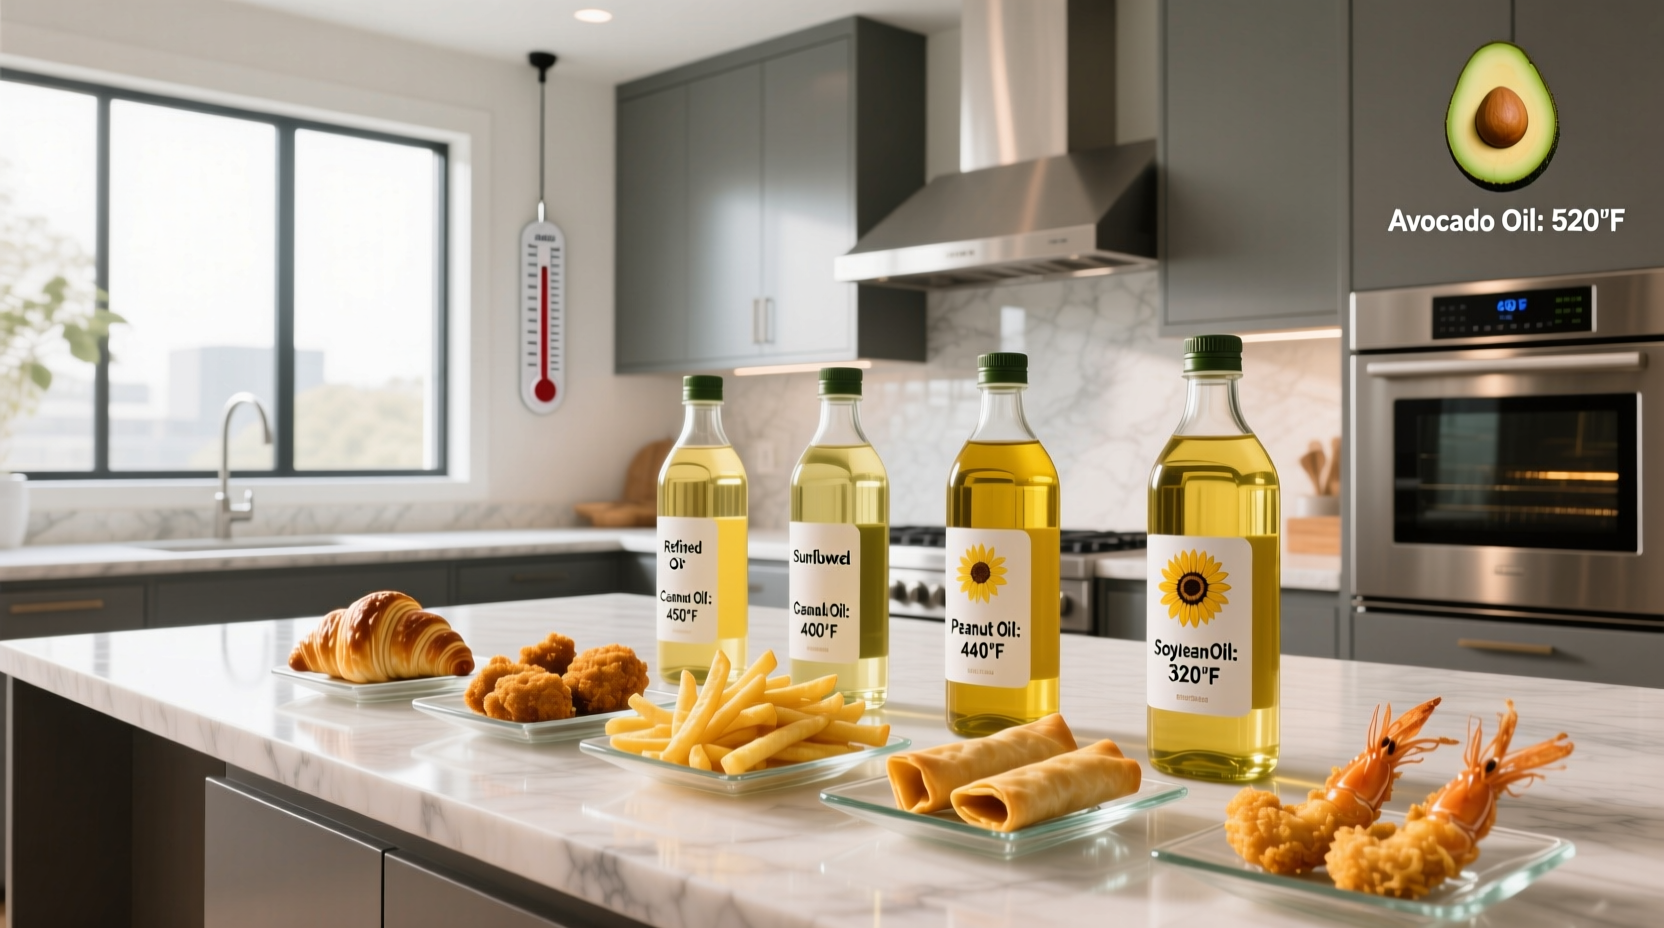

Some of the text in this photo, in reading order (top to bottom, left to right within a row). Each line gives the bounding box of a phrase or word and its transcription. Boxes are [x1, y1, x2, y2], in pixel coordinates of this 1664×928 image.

[830, 603, 850, 618] Oil:
[951, 618, 1021, 638] Peanut Oil:
